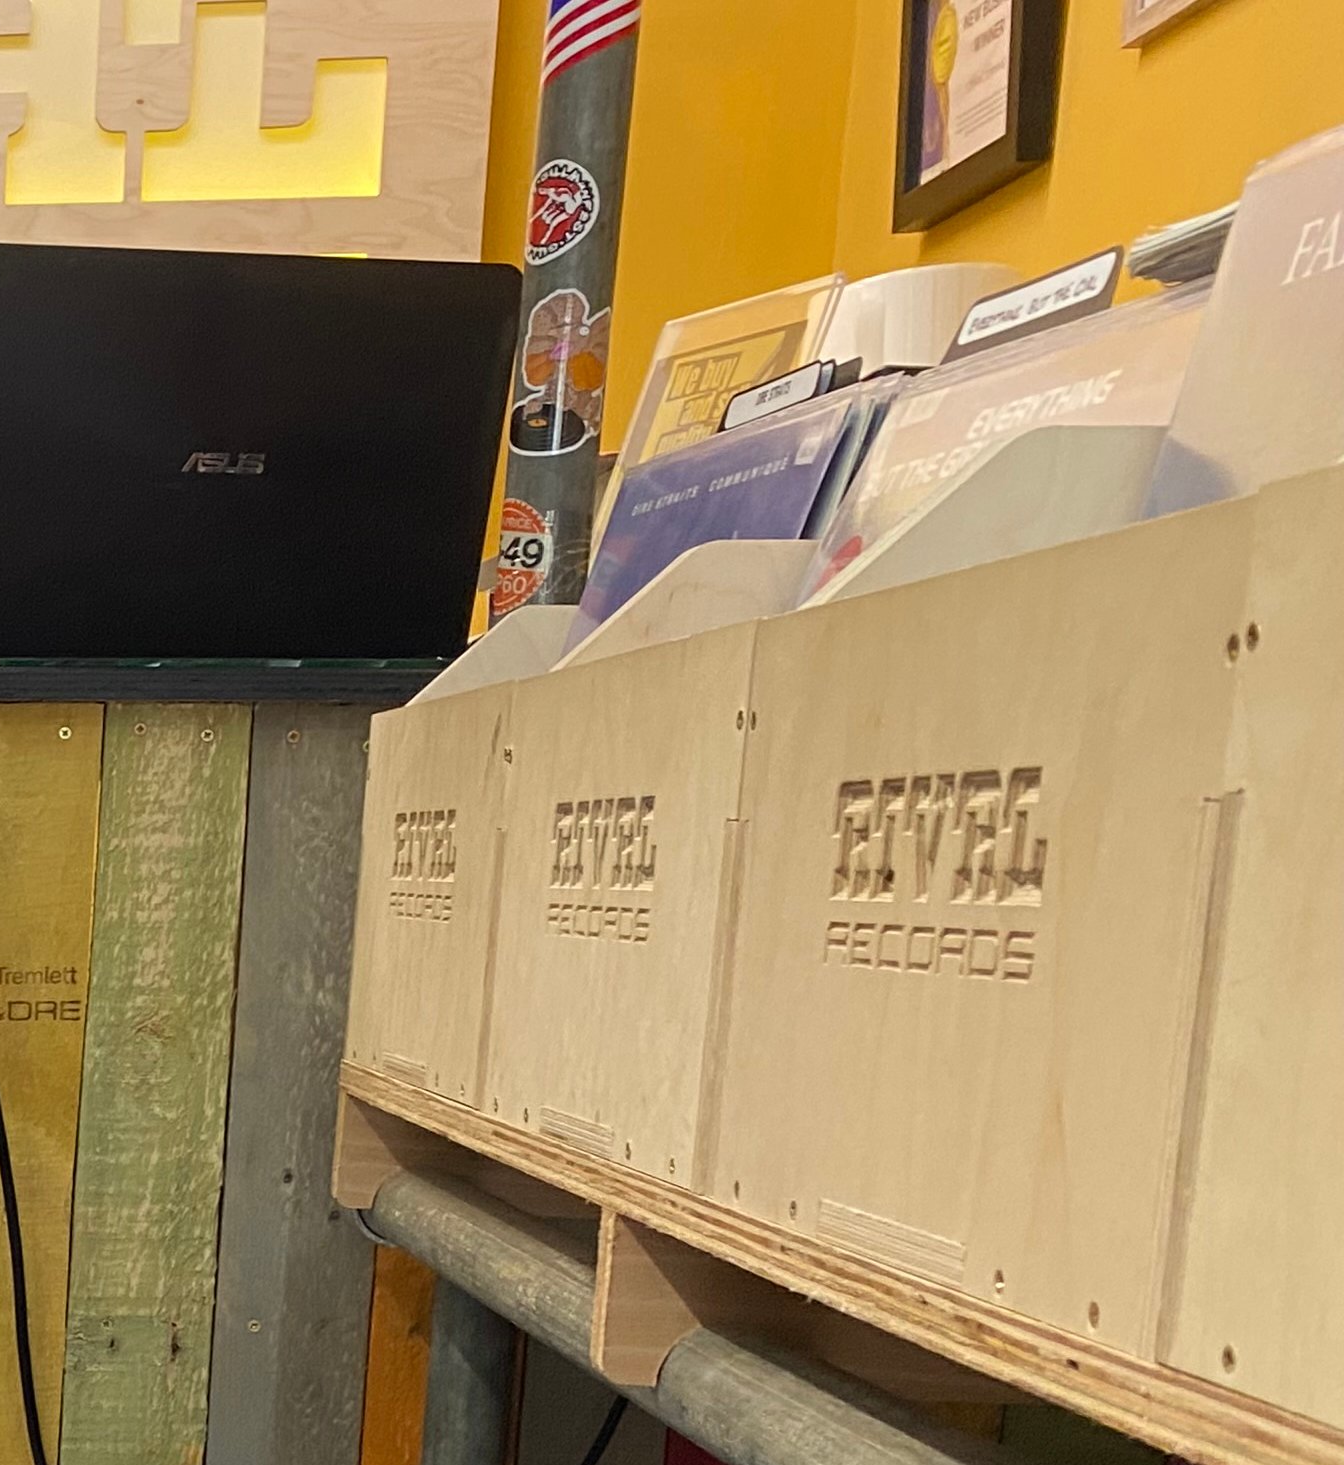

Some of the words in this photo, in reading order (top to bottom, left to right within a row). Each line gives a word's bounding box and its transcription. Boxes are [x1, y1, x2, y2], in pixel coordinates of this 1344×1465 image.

[1281, 212, 1344, 286] FA
[967, 369, 1123, 440] EVERYTHING
[181, 452, 266, 475] ASUS
[390, 809, 457, 883] RIVAL
[549, 795, 658, 892] RIVAL
[830, 765, 1047, 907] RIVAL
[389, 892, 454, 924] RECORDS
[547, 903, 652, 946] RECORDS
[825, 921, 1036, 984] RECORDS
[7, 1000, 82, 1022] DRE
